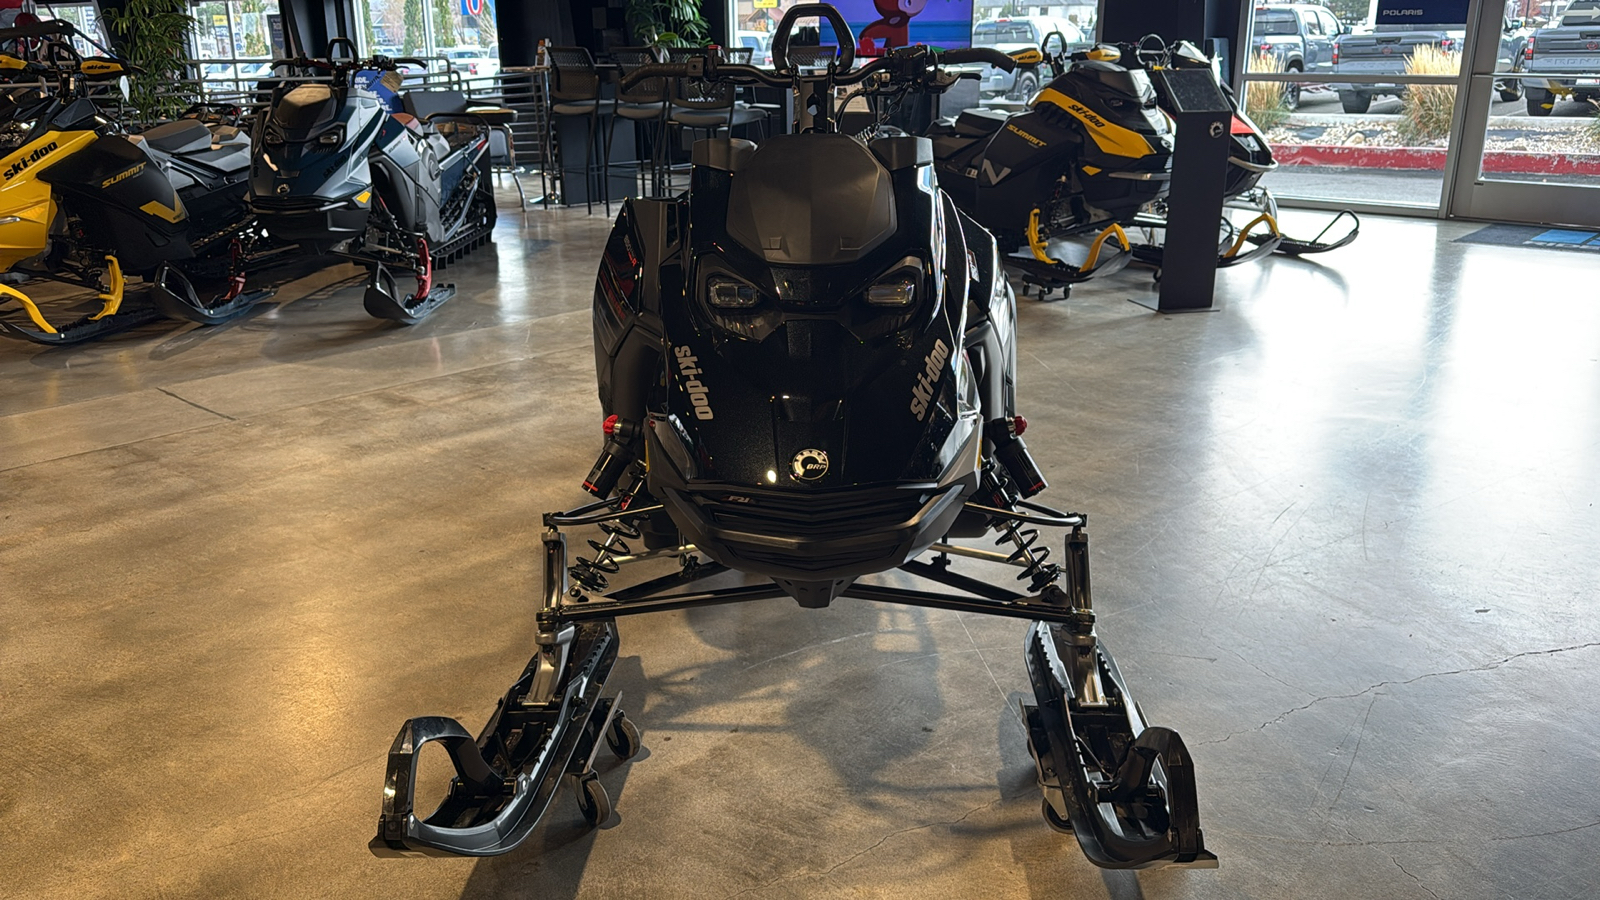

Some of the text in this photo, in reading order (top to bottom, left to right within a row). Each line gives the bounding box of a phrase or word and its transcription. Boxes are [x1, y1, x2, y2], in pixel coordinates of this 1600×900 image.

[1068, 103, 1106, 128] ski-doo
[1006, 124, 1048, 147] SUMMIT
[3, 141, 59, 181] ski-doo
[102, 161, 147, 189] SUMMIT
[674, 344, 714, 421] ski-doo
[910, 338, 950, 422] ski-doo
